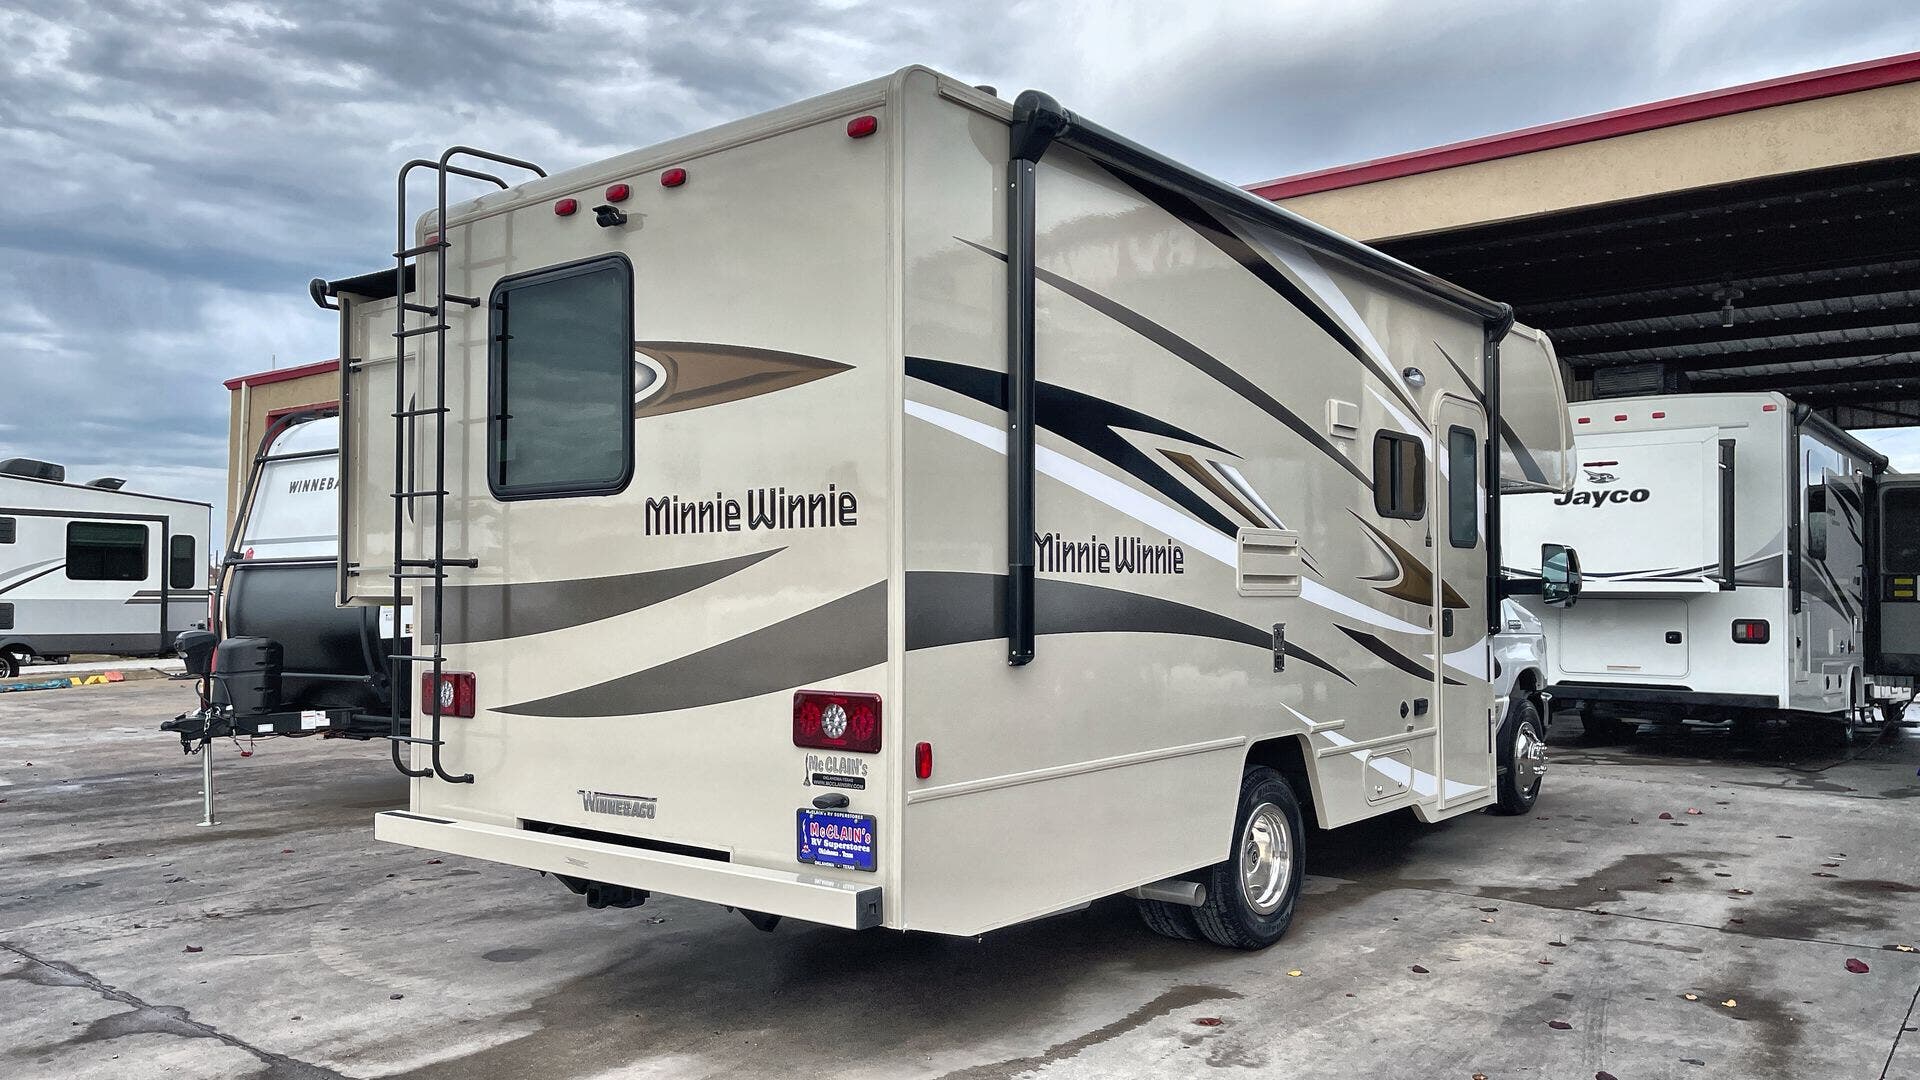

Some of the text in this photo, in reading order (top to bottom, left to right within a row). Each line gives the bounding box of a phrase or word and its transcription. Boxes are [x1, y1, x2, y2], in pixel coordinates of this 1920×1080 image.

[1554, 488, 1650, 508] Jayco
[645, 483, 857, 536] Minnie Winnie
[1034, 532, 1184, 574] Minnie Winnie
[810, 822, 871, 844] McCLAIN's
[811, 838, 871, 852] RV Superstores
